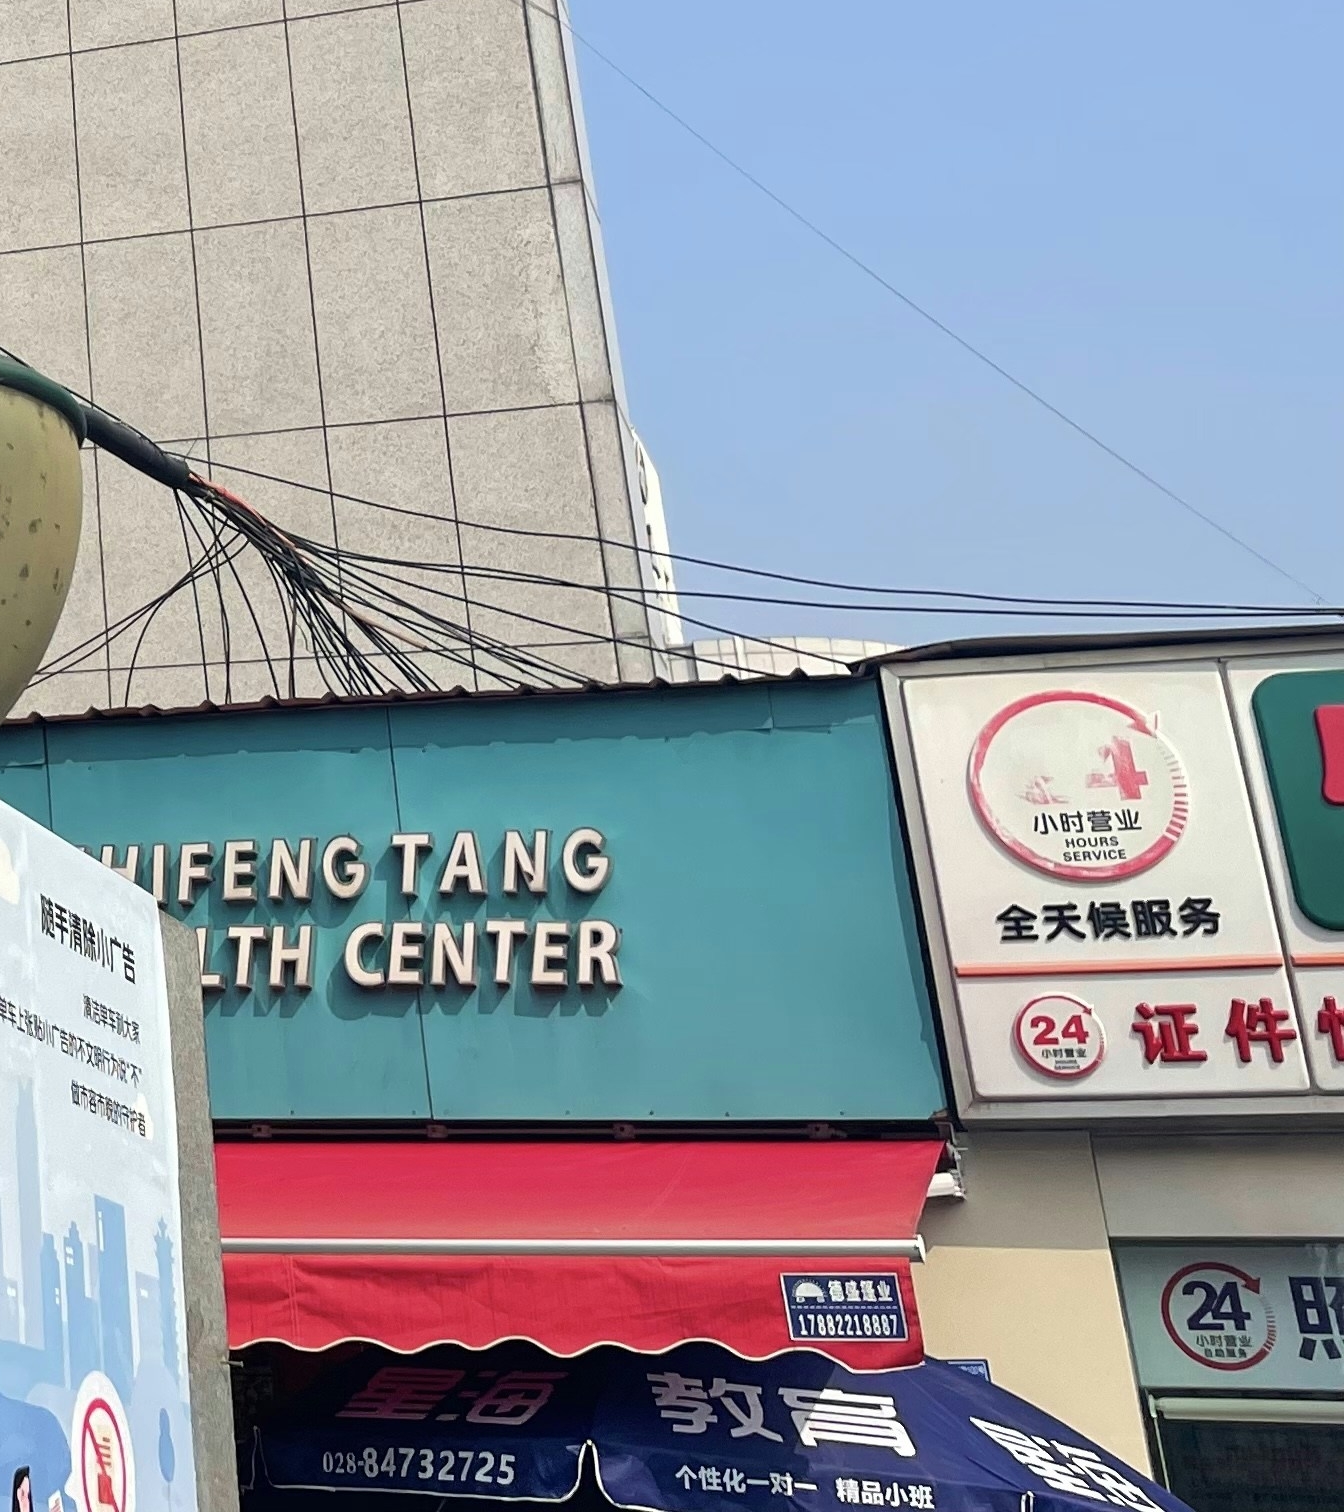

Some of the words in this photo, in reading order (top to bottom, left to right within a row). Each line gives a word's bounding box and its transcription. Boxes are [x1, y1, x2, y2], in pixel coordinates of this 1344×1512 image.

[1033, 808, 1143, 835] 小时营业
[1065, 835, 1120, 849] HOURS
[390, 827, 612, 896] TANG
[1062, 848, 1128, 863] SERVICE
[40, 893, 136, 985] 随手清除小广告
[995, 896, 1221, 945] 全天候服务
[343, 918, 623, 988] CENTER
[1030, 1014, 1090, 1046] 24
[798, 1313, 898, 1337] 17882218887
[1181, 1280, 1252, 1332] 24
[646, 1371, 917, 1458] 教育
[322, 1447, 516, 1486] 028-84732725
[675, 1464, 819, 1497] 个性化一对一
[835, 1477, 936, 1510] 精品小班
